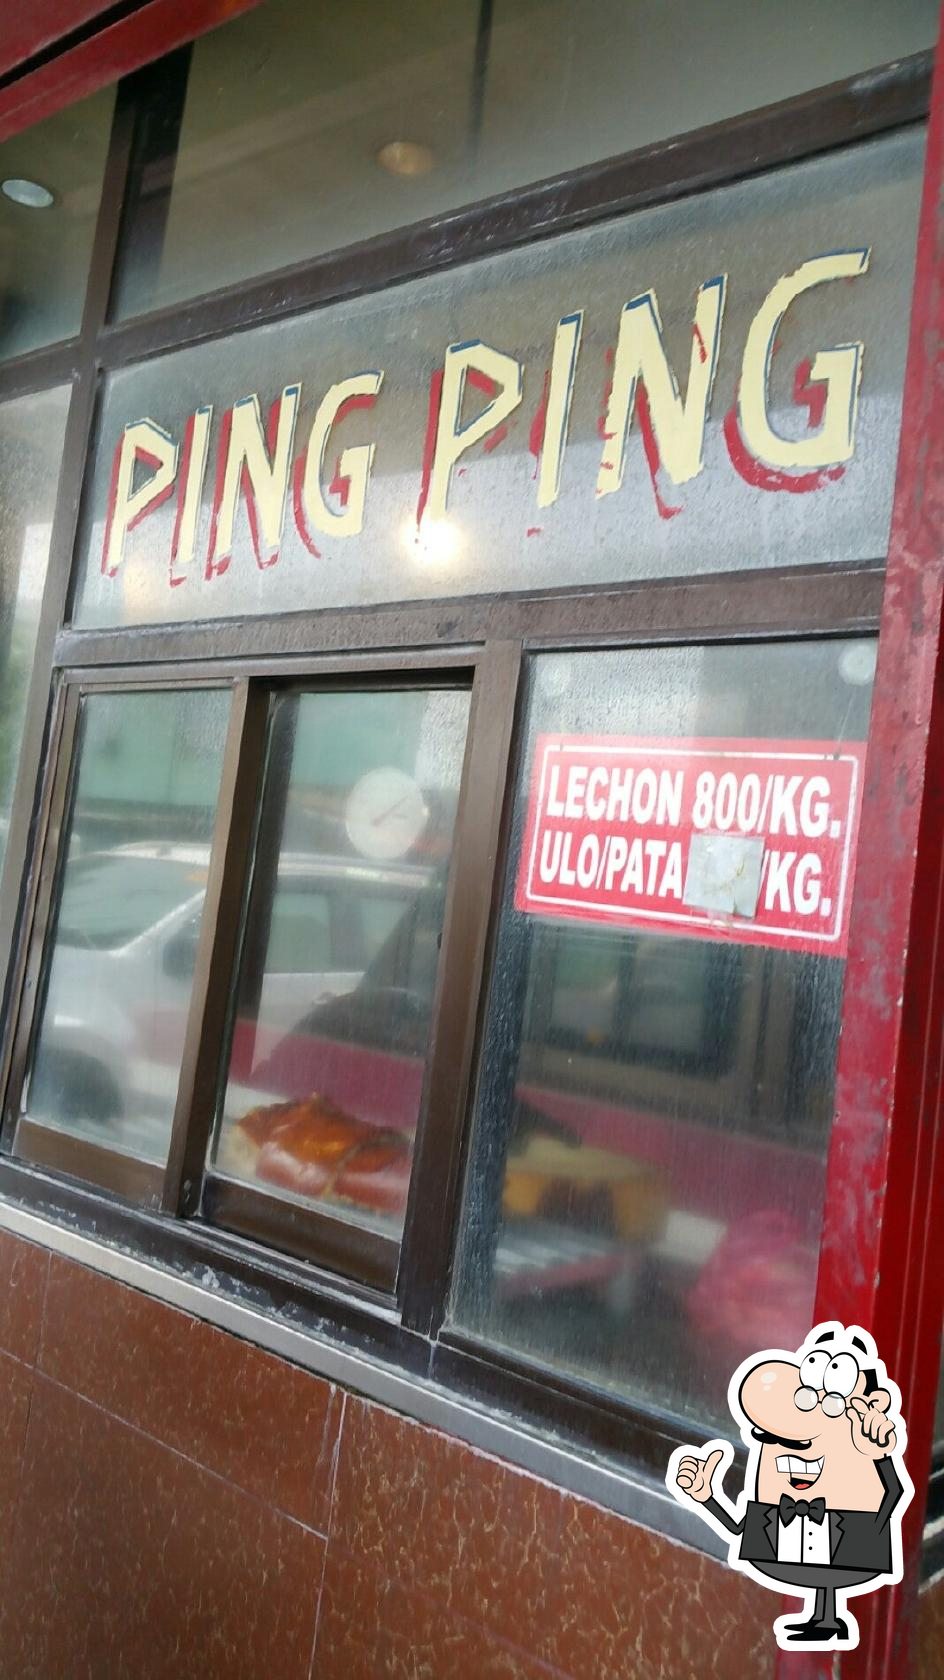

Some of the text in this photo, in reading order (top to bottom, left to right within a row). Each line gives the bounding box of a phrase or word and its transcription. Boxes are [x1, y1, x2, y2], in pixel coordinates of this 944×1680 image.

[103, 247, 873, 584] PING PING
[546, 764, 842, 839] LECHON 800/KG.
[539, 830, 683, 899] ULO/PATA
